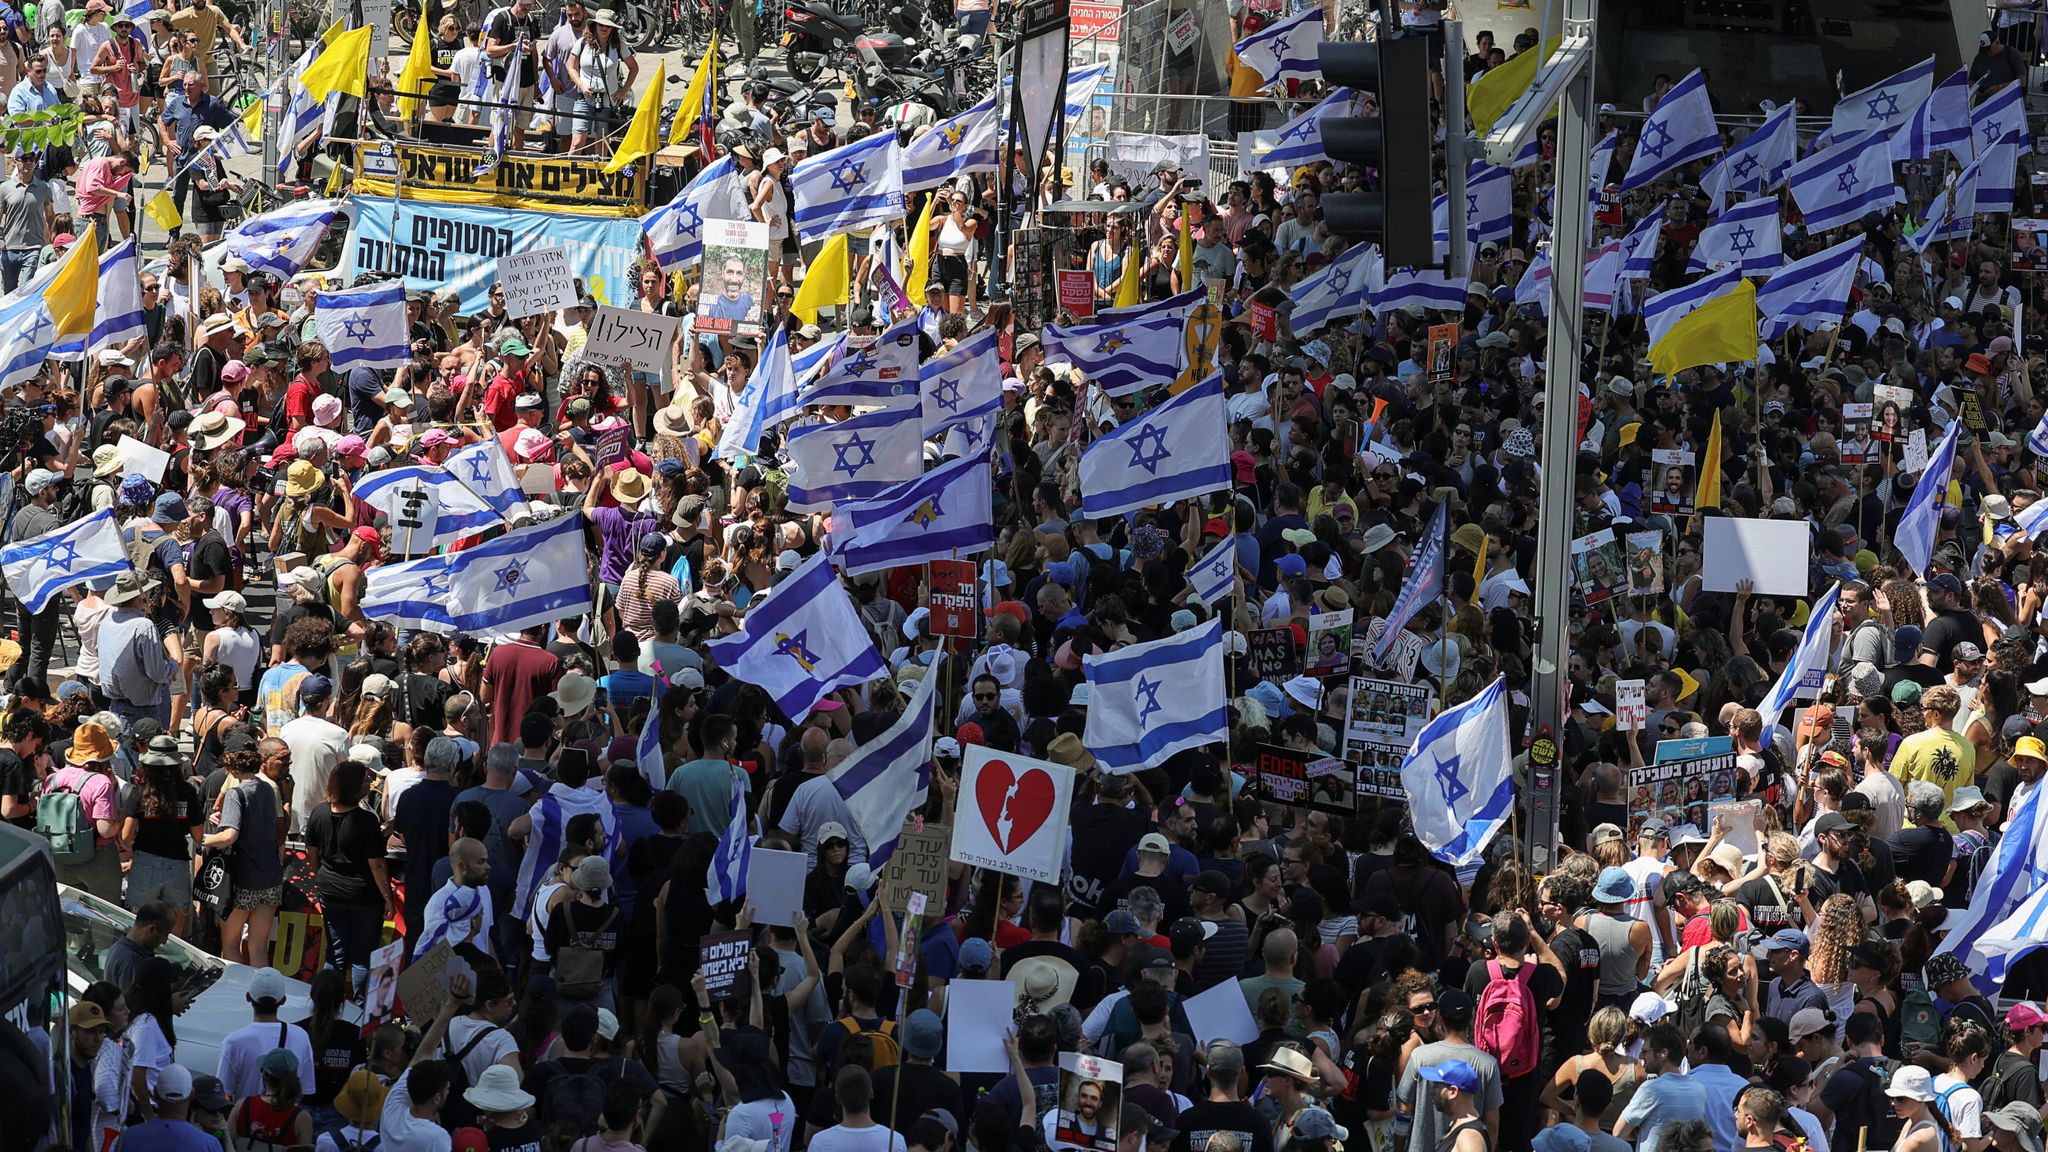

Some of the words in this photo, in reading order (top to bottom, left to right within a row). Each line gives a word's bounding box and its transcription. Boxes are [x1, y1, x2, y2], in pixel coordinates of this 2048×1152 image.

[1072, 8, 1093, 17] החניה
[1095, 10, 1117, 19] אסורה
[496, 162, 534, 190] את
[542, 162, 635, 197] מצילים
[1600, 192, 1609, 202] כול
[411, 214, 512, 258] החטופים
[509, 255, 536, 269] הורים
[541, 249, 564, 262] איזה
[508, 273, 523, 284] את
[505, 285, 529, 301] שלהם
[533, 279, 569, 293] הילדים
[1062, 288, 1091, 296] עסקה
[519, 294, 560, 315] בשבי?
[696, 316, 714, 328] HOME
[714, 318, 732, 330] NOW!
[596, 313, 663, 350] הצילו!
[637, 359, 650, 368] את
[1252, 630, 1287, 645] WAR
[1254, 645, 1286, 661] HAS
[1262, 661, 1282, 673] NO
[1357, 679, 1390, 694] בשבילן
[1392, 684, 1426, 698] זועקות
[1260, 751, 1304, 780] EDEN
[1686, 754, 1734, 775] זועקות
[1631, 764, 1682, 787] בשבילן
[915, 839, 942, 853] עוד
[959, 851, 974, 861] שלך
[975, 855, 997, 867] בצורה
[1000, 860, 1013, 871] בלב
[1015, 864, 1028, 874] חור
[1030, 866, 1037, 876] לי
[891, 866, 906, 881] יום
[917, 870, 941, 884] עוד
[1039, 869, 1049, 878] יש
[1754, 911, 1780, 922] FAMILIES
[710, 942, 733, 960] שלום
[735, 940, 749, 957] רק
[729, 955, 748, 972] יביא
